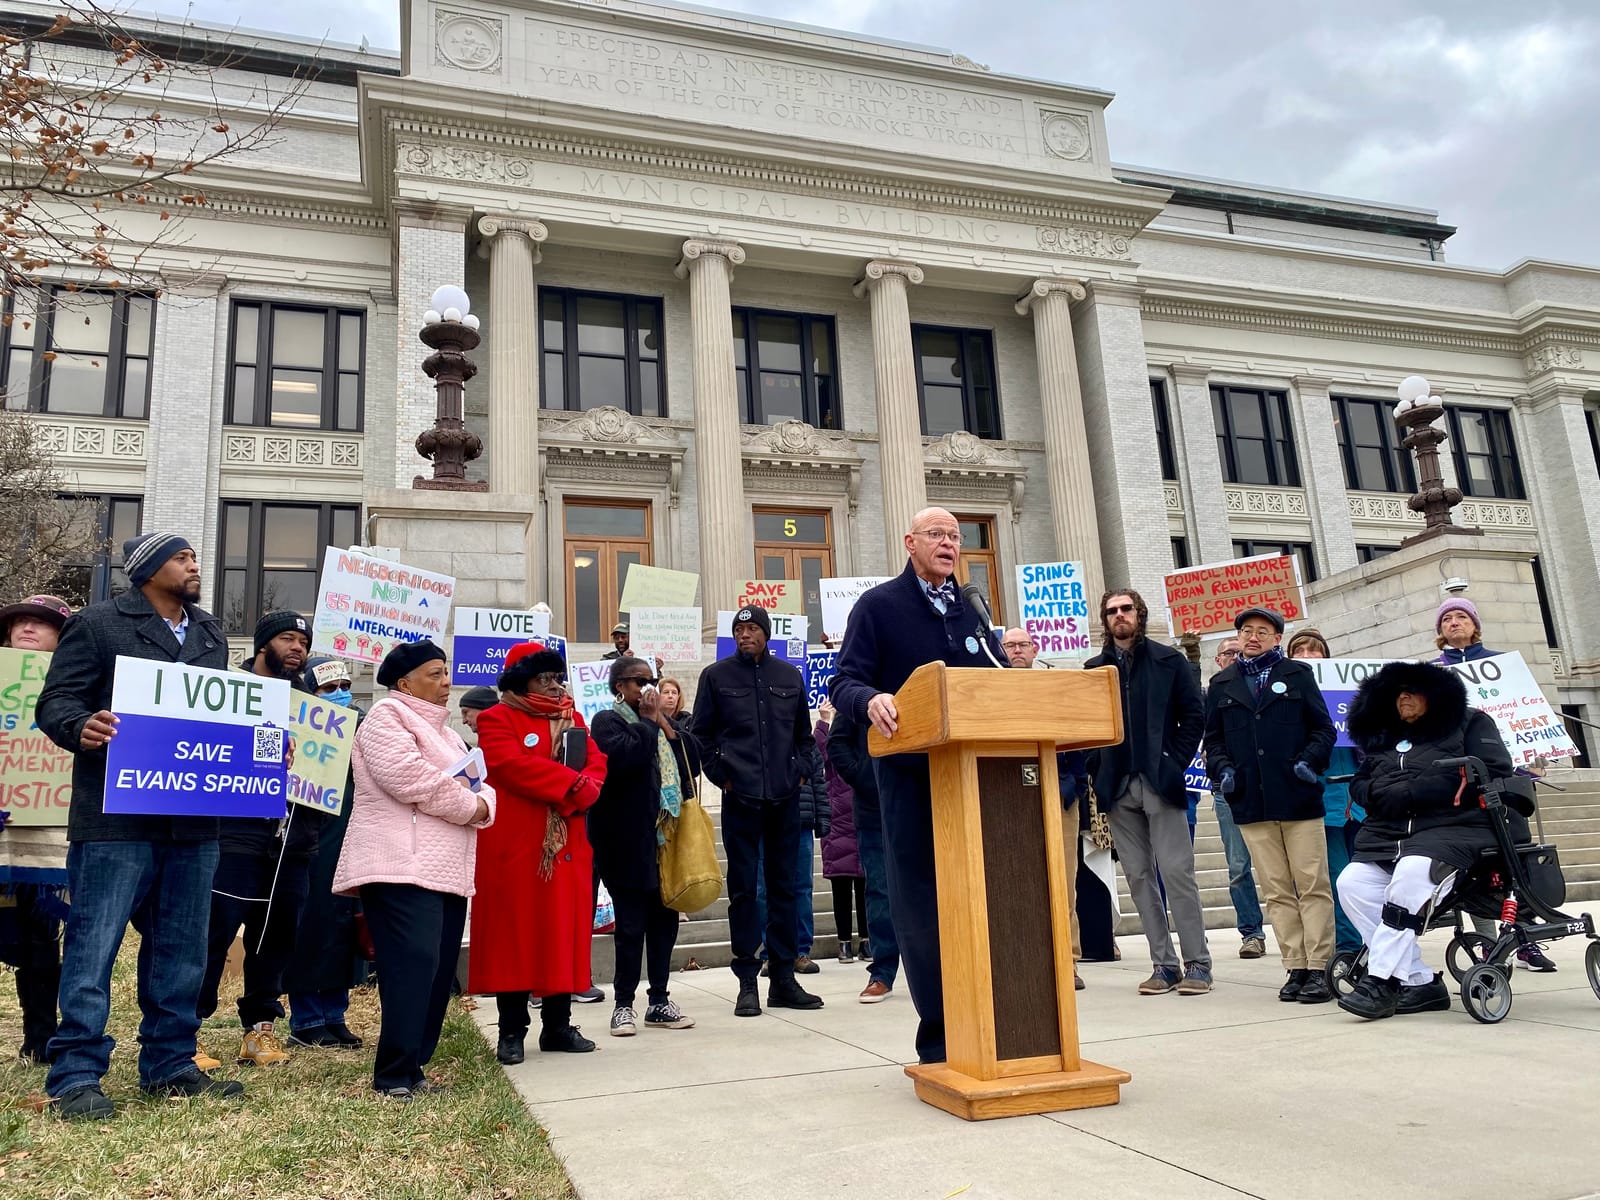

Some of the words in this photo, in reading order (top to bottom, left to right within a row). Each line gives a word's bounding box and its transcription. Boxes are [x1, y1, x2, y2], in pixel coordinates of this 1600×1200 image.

[555, 30, 661, 61] ERECTED
[673, 50, 713, 69] A.D.
[723, 57, 833, 88] NINETEEN
[849, 78, 949, 107] HVNDRED
[960, 96, 1002, 115] AND
[607, 58, 698, 85] FIFTEEN
[723, 76, 747, 92] IN
[762, 82, 805, 102] THE
[539, 66, 602, 91] YEAR
[614, 79, 644, 97] OF
[657, 85, 703, 106] THE
[715, 94, 763, 115] CITY
[774, 103, 801, 120] OF
[814, 109, 913, 137] ROANOKE
[924, 126, 1017, 152] VIRGINIA
[580, 170, 798, 218] MVNICIPAL
[836, 204, 1001, 243] BVILDING
[783, 519, 797, 537] 5
[1023, 563, 1075, 584] SRING
[1224, 564, 1243, 578] NO
[1246, 556, 1291, 574] MORE
[371, 580, 411, 604] NOT
[418, 597, 429, 608] A
[745, 581, 787, 596] SAVE
[826, 590, 860, 599] EVANS
[1024, 582, 1083, 601] WATER
[1166, 584, 1205, 603] URBAN
[325, 591, 350, 612] 55
[401, 611, 440, 632] DOLLAR
[738, 595, 777, 609] EVANS
[1024, 600, 1087, 618] MATTERS
[1172, 603, 1198, 618] HEY
[474, 612, 479, 631] I
[489, 612, 534, 633] VOTE
[772, 617, 792, 635] TE
[1026, 617, 1077, 634] EVANS
[1031, 634, 1090, 652] SPRING
[485, 648, 511, 659] SAV
[457, 663, 499, 674] EVANS
[578, 665, 611, 682] EVA
[1317, 663, 1323, 684] I
[1335, 663, 1383, 684] VOT
[1450, 660, 1502, 685] NO
[154, 669, 163, 705] I
[183, 672, 264, 717] VOTE
[1477, 686, 1500, 700] to
[1497, 711, 1515, 720] day
[1508, 714, 1549, 732] HEAT
[1515, 723, 1567, 745] ASPHALT
[174, 741, 233, 763] SAVE
[302, 740, 338, 766] OF
[116, 769, 198, 792] EVANS
[202, 773, 281, 796] SPRING
[287, 773, 341, 809] RING
[0, 781, 73, 809] USTIC
[1566, 921, 1586, 934] F-22
